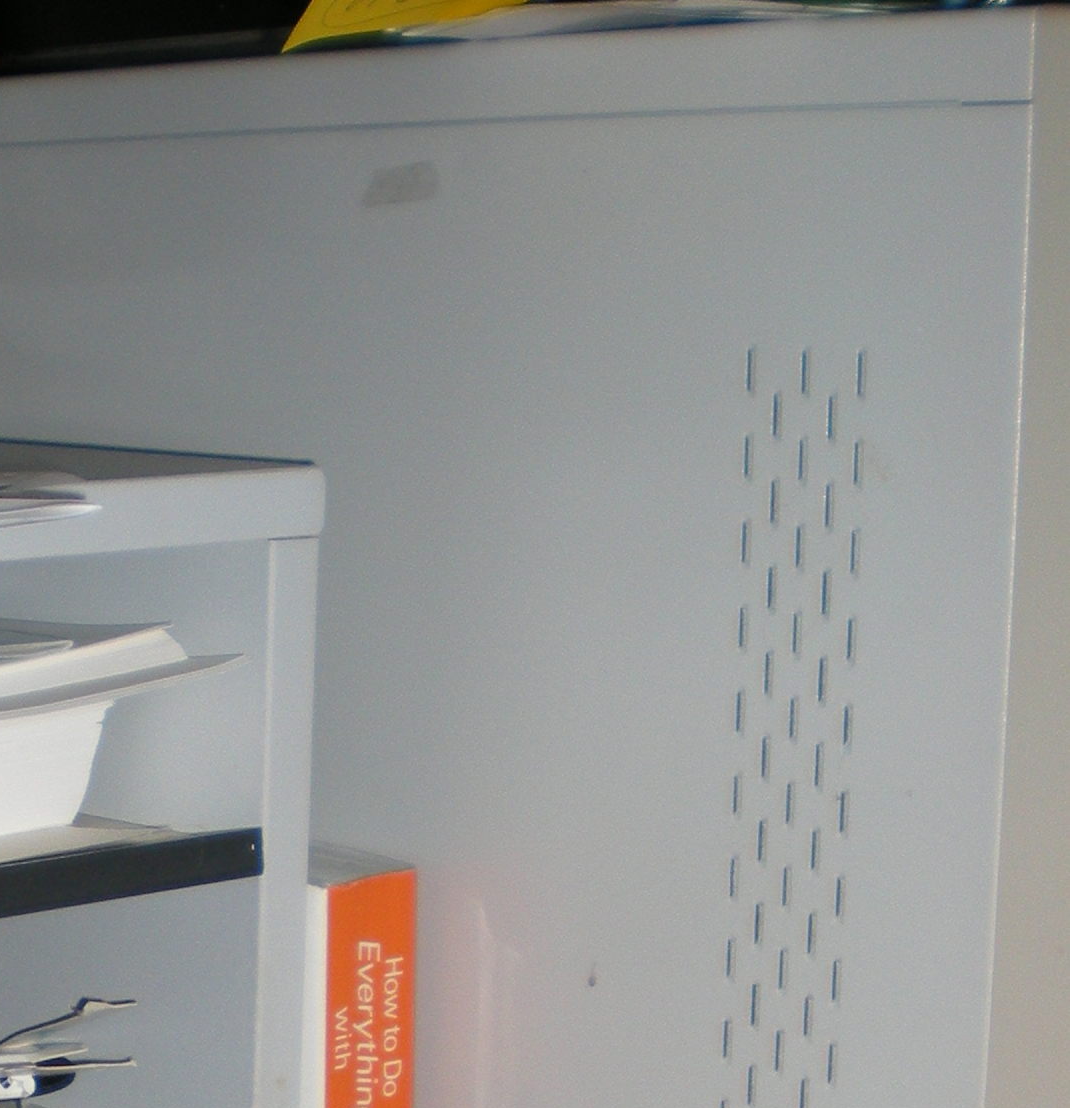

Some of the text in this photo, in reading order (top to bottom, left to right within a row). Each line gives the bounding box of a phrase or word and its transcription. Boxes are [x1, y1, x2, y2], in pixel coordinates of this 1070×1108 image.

[334, 1006, 352, 1071] with
[383, 956, 404, 1097] How to Do
